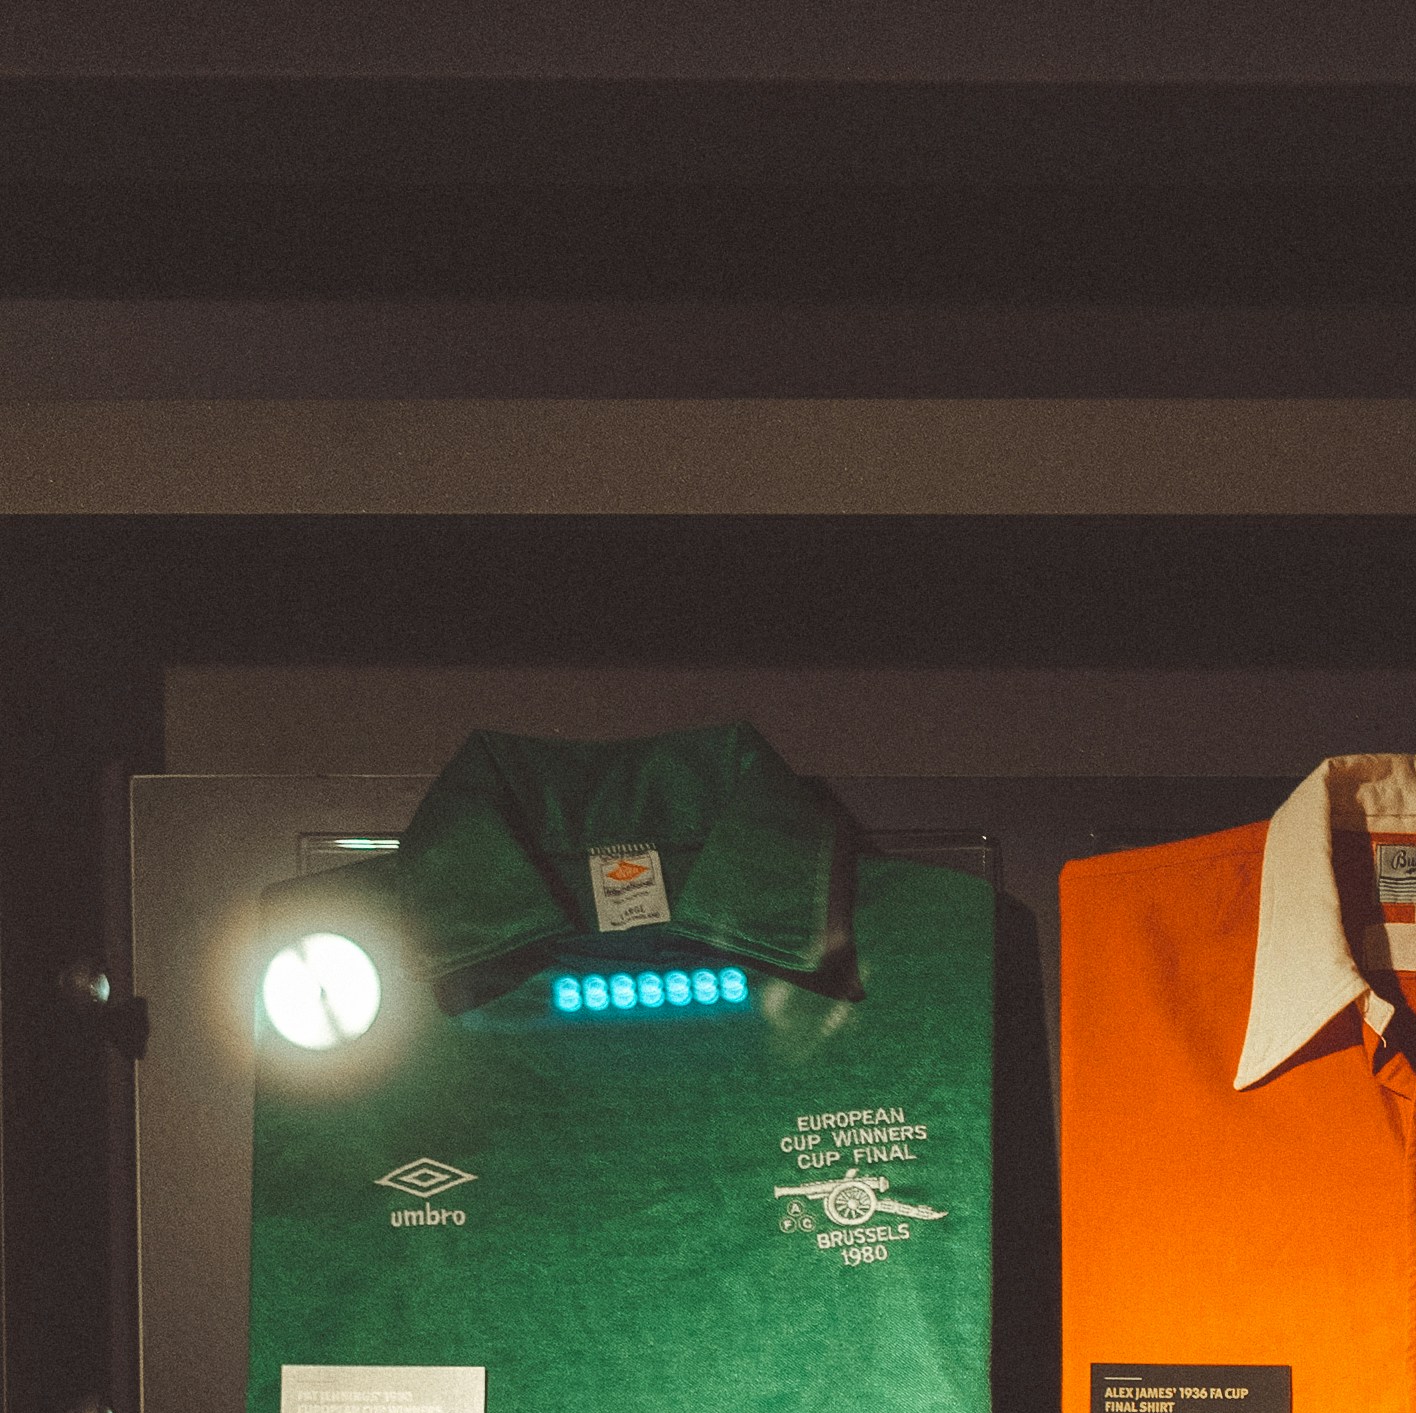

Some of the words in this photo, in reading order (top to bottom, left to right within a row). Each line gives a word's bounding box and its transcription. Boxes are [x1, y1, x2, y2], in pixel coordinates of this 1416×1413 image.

[797, 1108, 905, 1131] EUROPEAN
[781, 1135, 821, 1152] CUP
[832, 1126, 927, 1147] WINNERS
[798, 1151, 840, 1169] CUP
[853, 1144, 917, 1164] FINAL
[391, 1202, 465, 1227] umbro
[817, 1223, 910, 1249] BRUSSELS
[841, 1245, 887, 1267] 1980
[1104, 1387, 1133, 1398] ALEX
[1135, 1387, 1177, 1400] JAMES'
[1180, 1387, 1208, 1399] 1936
[1210, 1388, 1223, 1399] FA
[1225, 1388, 1249, 1399] CUP
[1105, 1402, 1138, 1413] FINAL
[1140, 1402, 1175, 1413] SHIRT
